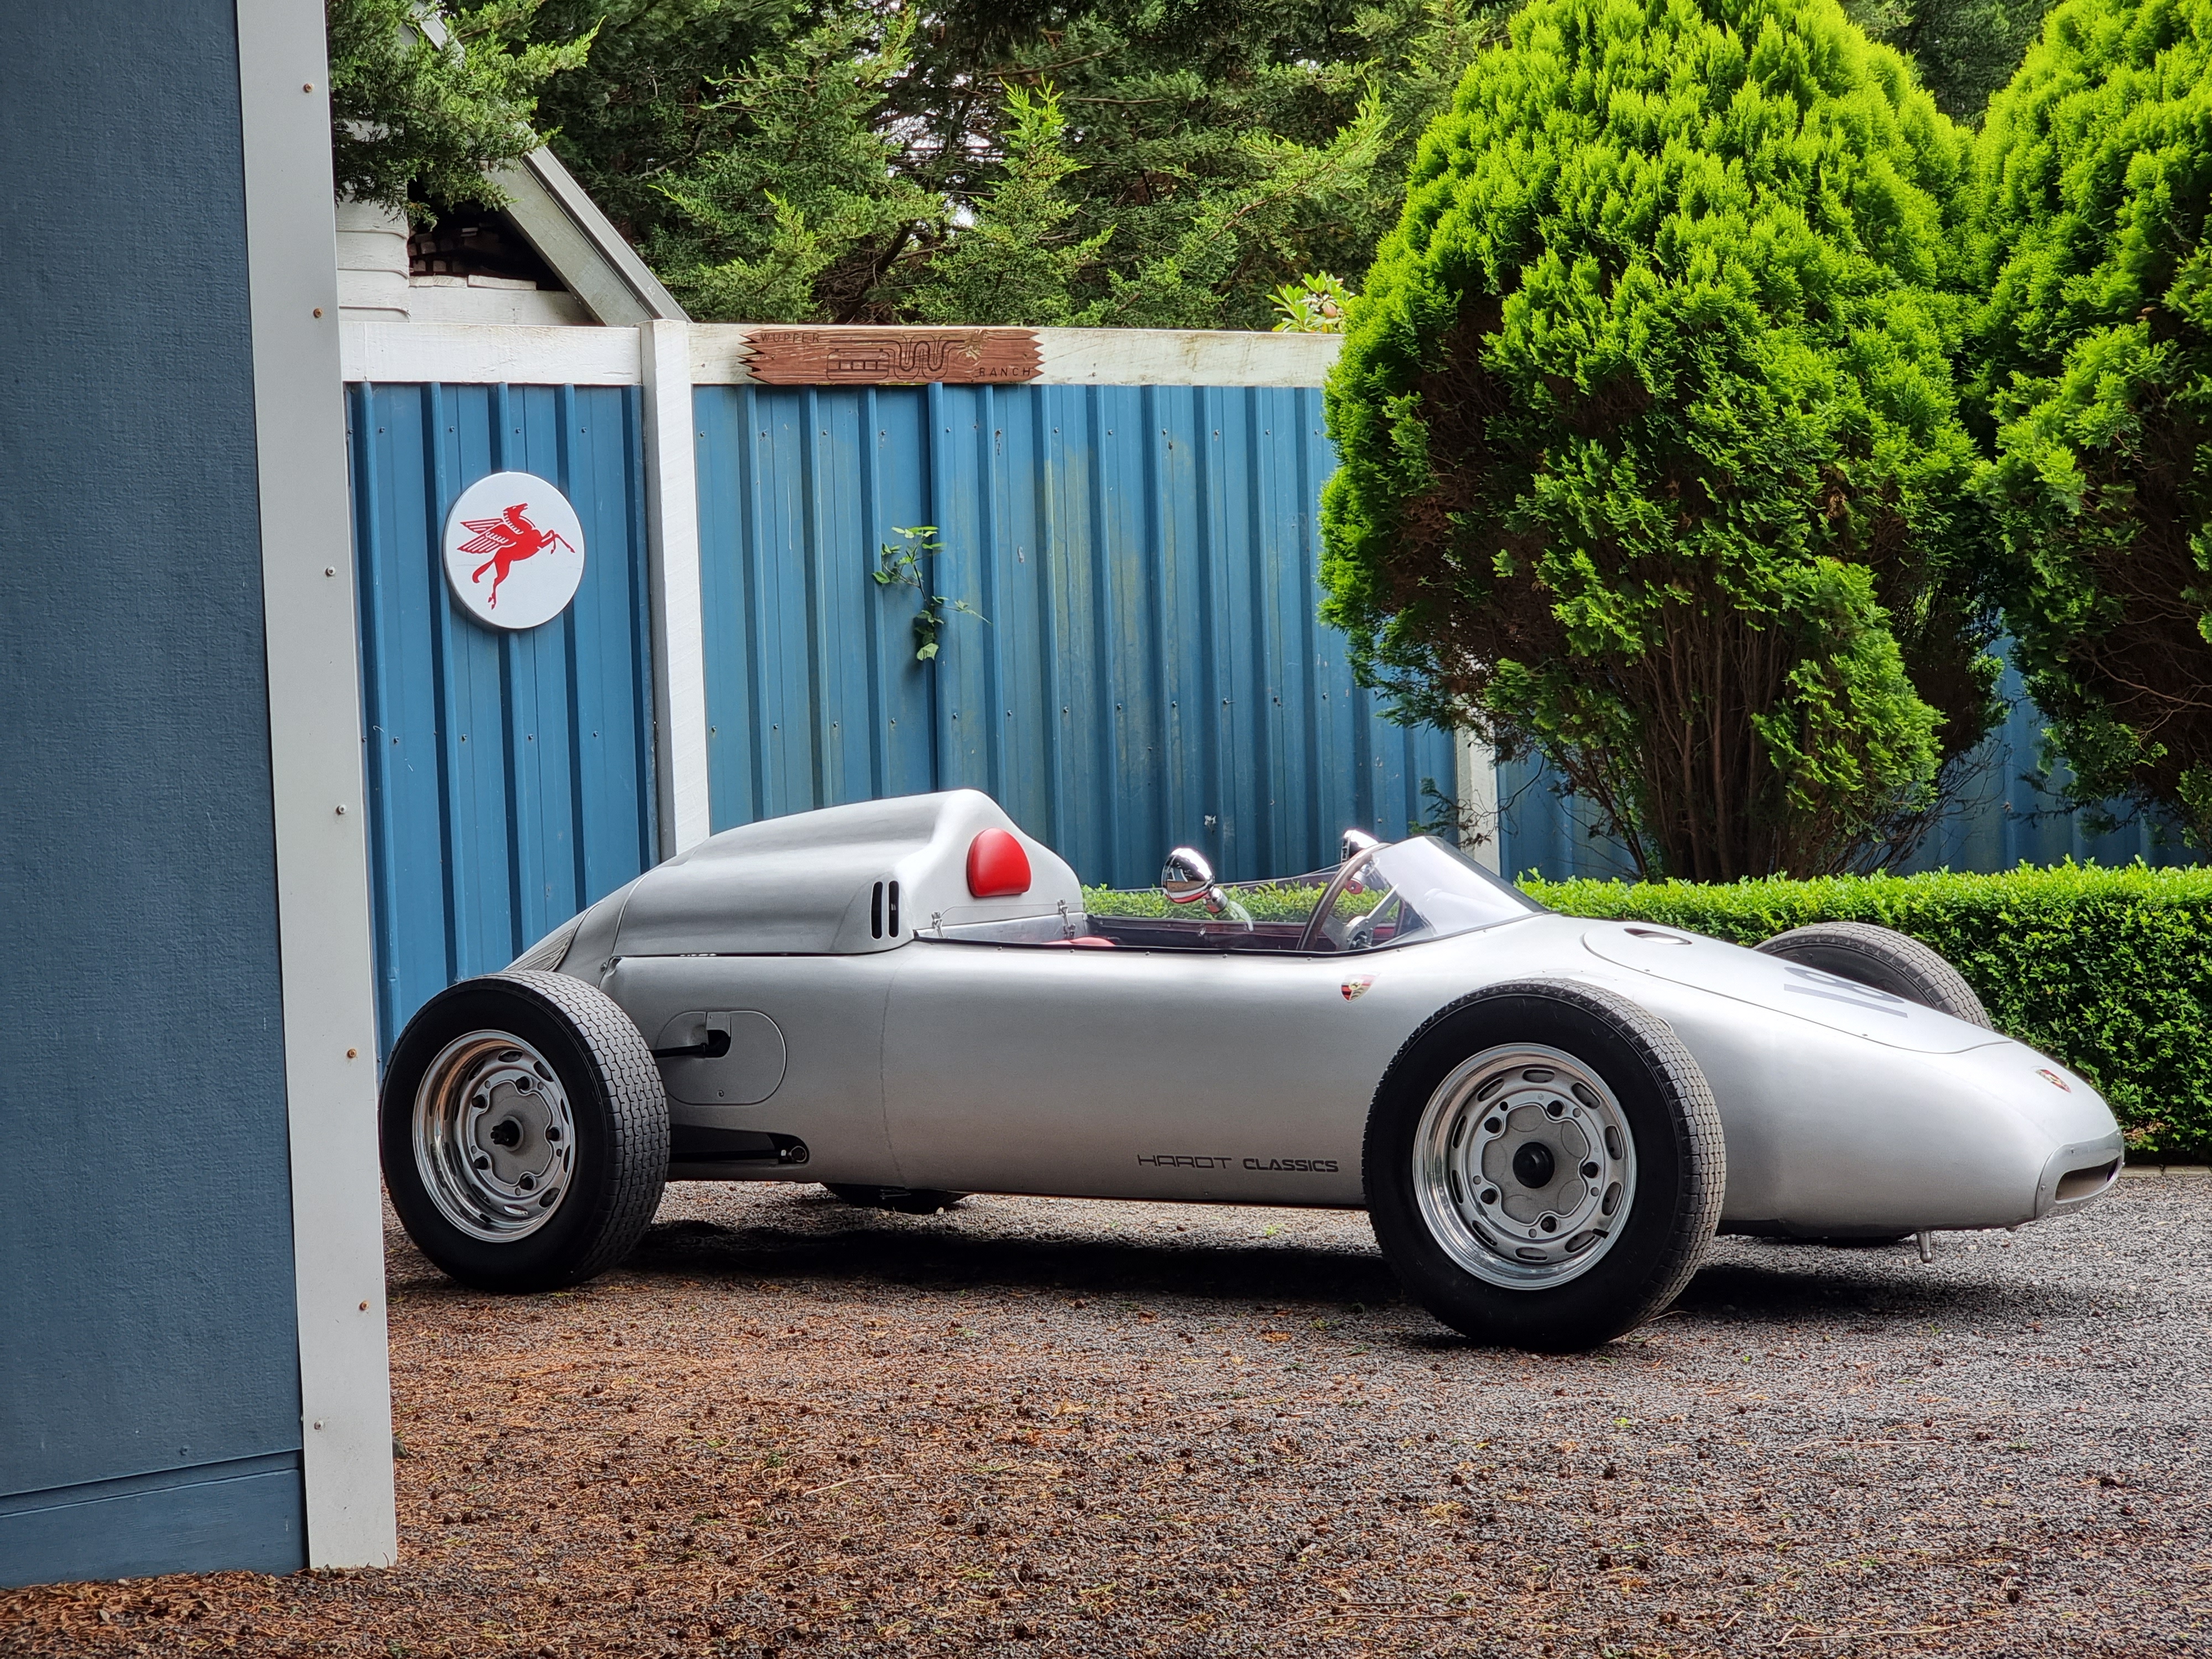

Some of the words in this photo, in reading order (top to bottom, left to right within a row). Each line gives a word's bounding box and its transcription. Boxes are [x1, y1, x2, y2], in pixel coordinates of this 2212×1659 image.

[761, 332, 820, 343] WUPPER
[979, 367, 1031, 377] RANCH
[1243, 1158, 1339, 1172] CLASSICS
